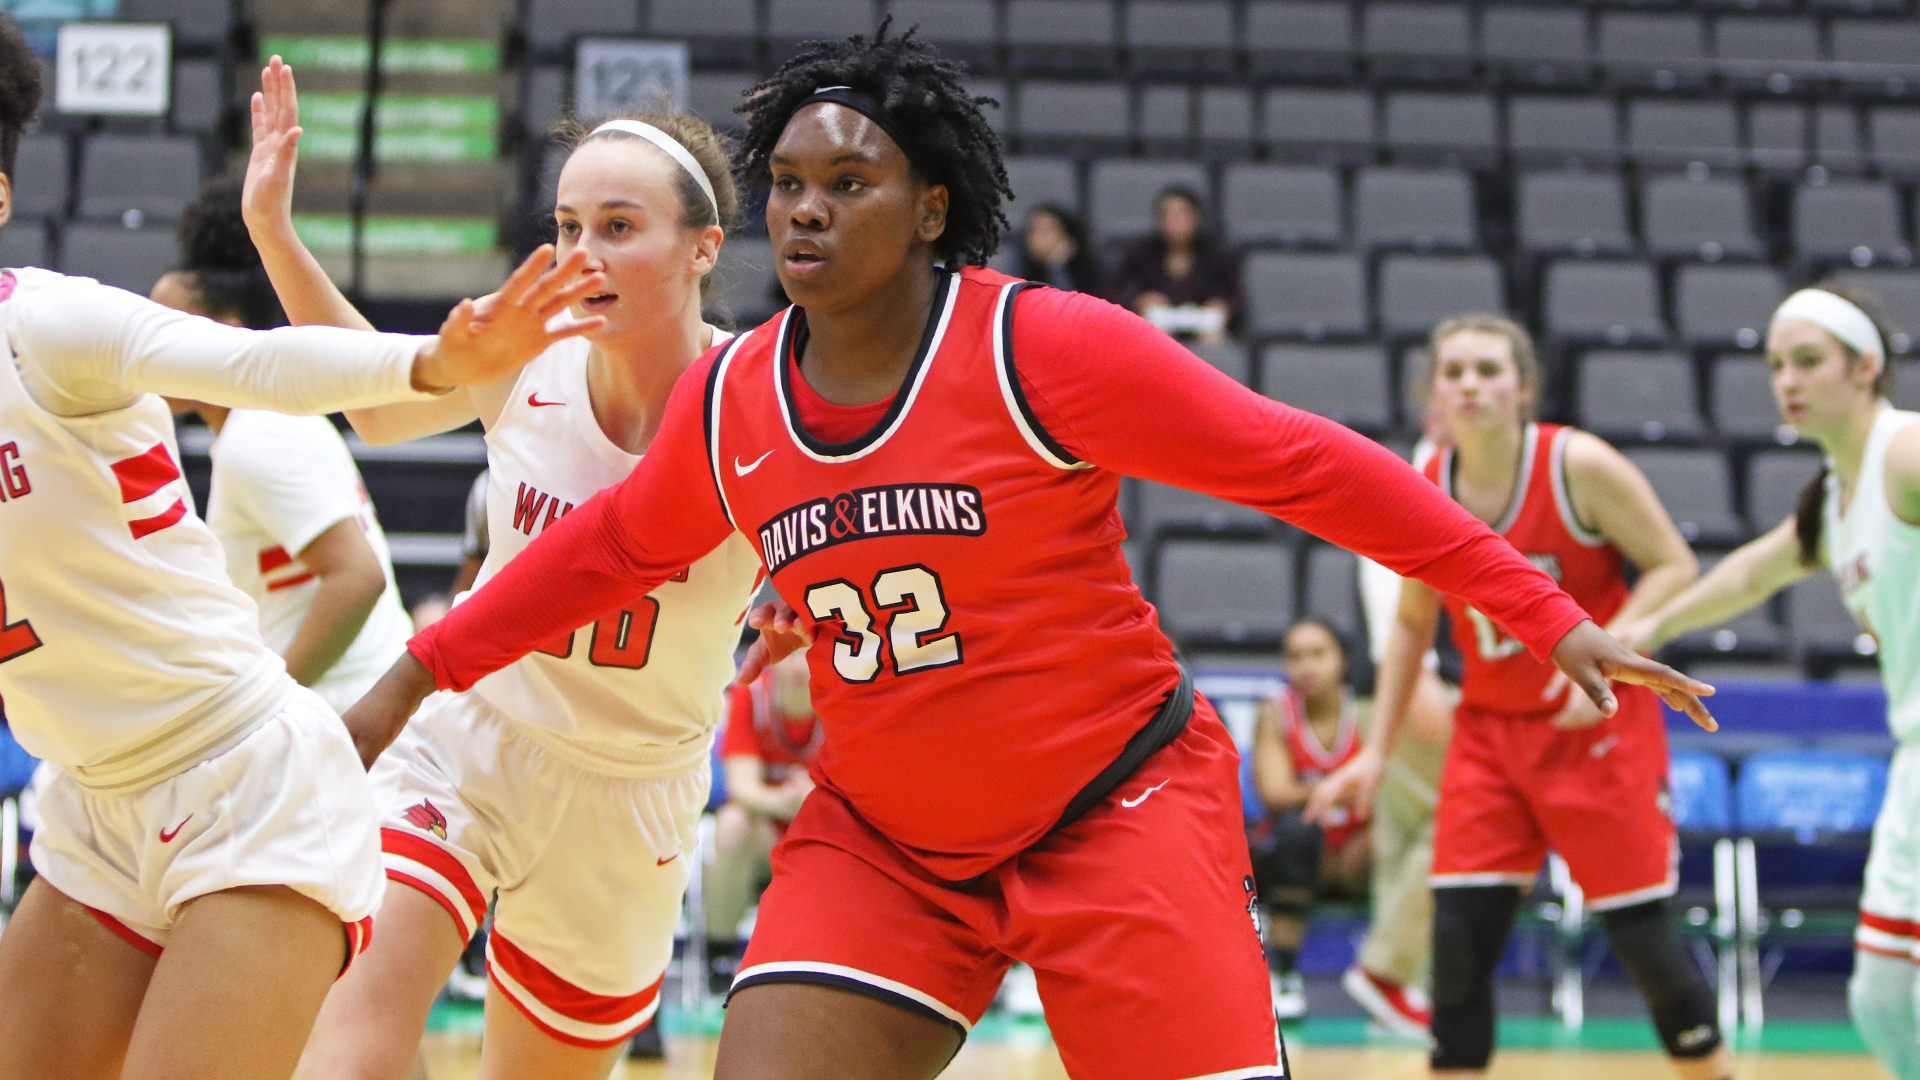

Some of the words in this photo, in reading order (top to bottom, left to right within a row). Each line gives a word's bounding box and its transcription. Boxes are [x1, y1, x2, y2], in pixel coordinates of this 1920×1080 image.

[74, 42, 156, 94] 122
[0, 441, 31, 501] G
[804, 563, 964, 684] 32
